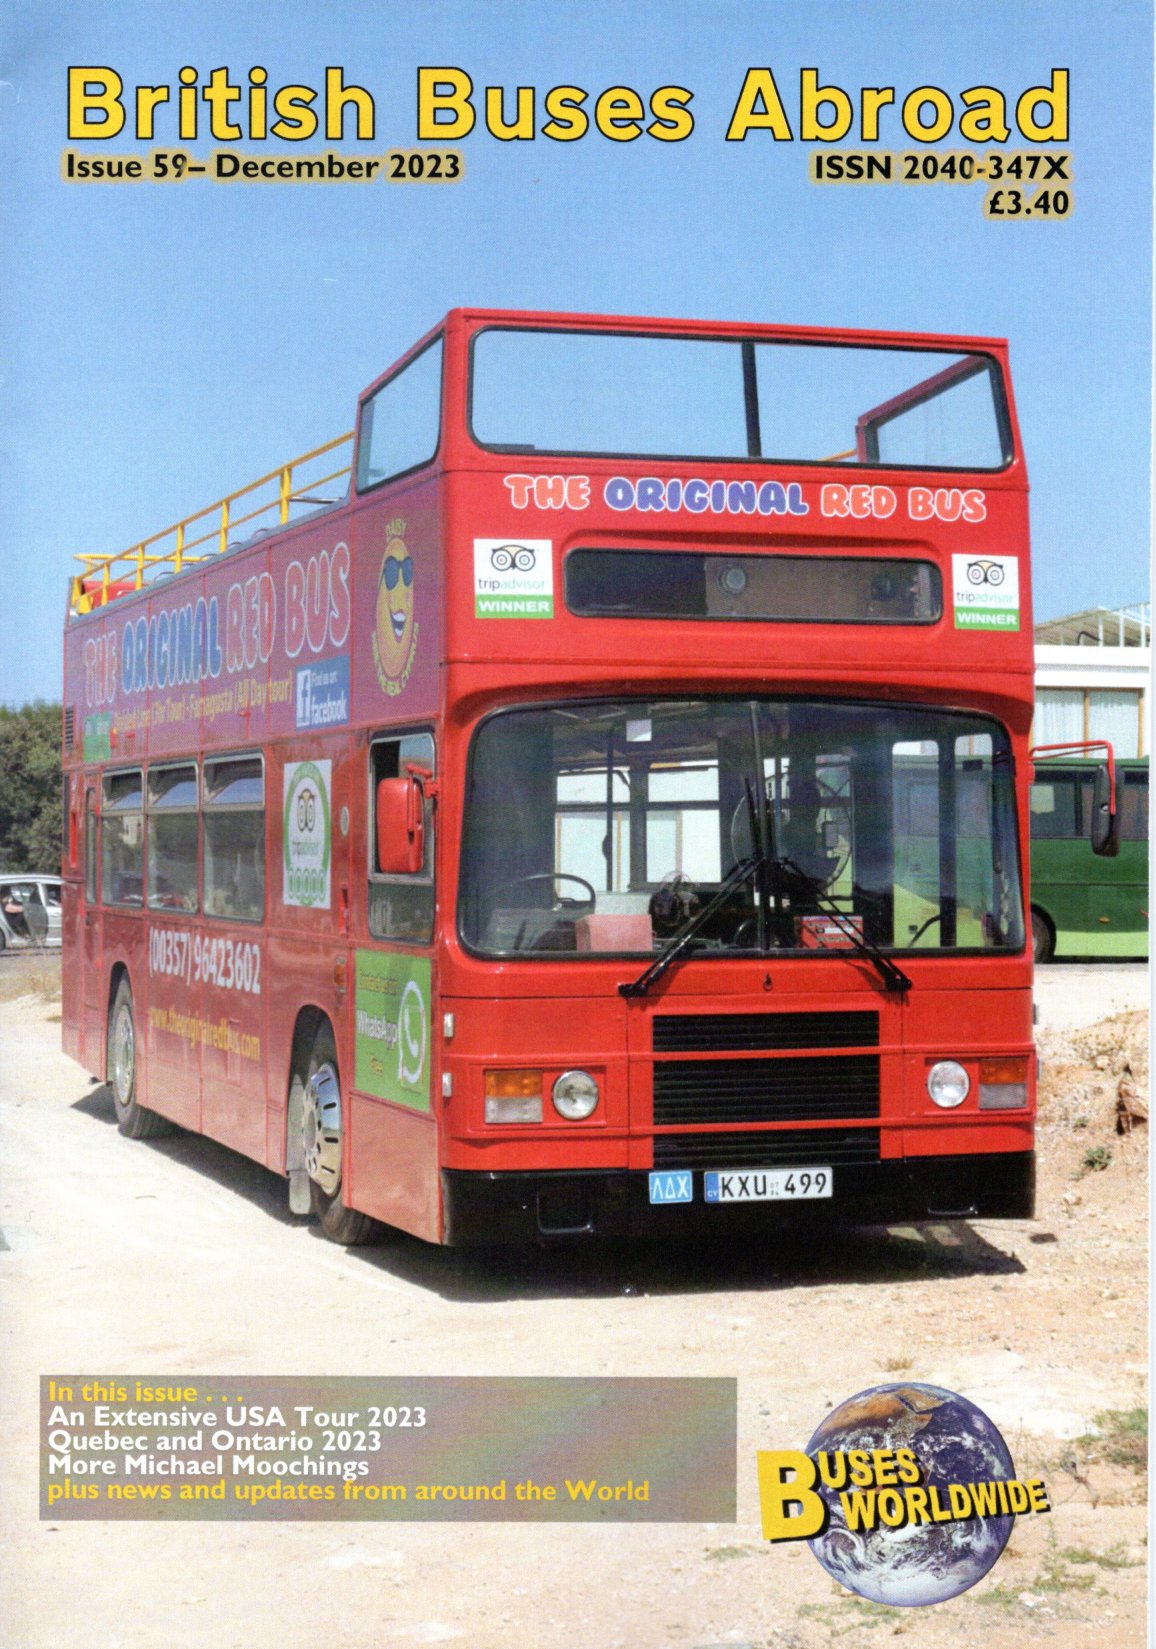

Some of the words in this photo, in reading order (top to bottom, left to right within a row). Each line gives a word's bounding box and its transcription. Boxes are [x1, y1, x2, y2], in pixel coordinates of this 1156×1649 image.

[502, 474, 593, 511] THE
[604, 476, 809, 518] ORIGINAL
[819, 484, 897, 520] RED
[907, 486, 987, 523] BUS
[478, 577, 547, 591] tripadvisor
[479, 599, 551, 613] WINNER
[956, 591, 1014, 604] tripadvisor
[84, 631, 117, 708] THE
[122, 596, 222, 694] ORIGINAL
[227, 572, 276, 673] RED
[285, 541, 351, 658] BUS
[957, 611, 1017, 624] WINNER
[312, 688, 347, 725] facebook
[149, 927, 191, 986] (00357)
[194, 932, 262, 996] 96423602
[355, 1009, 398, 1050] WhatsApp
[707, 1190, 718, 1198] CY
[721, 1174, 767, 1198] KXU
[784, 1172, 827, 1195] 499
